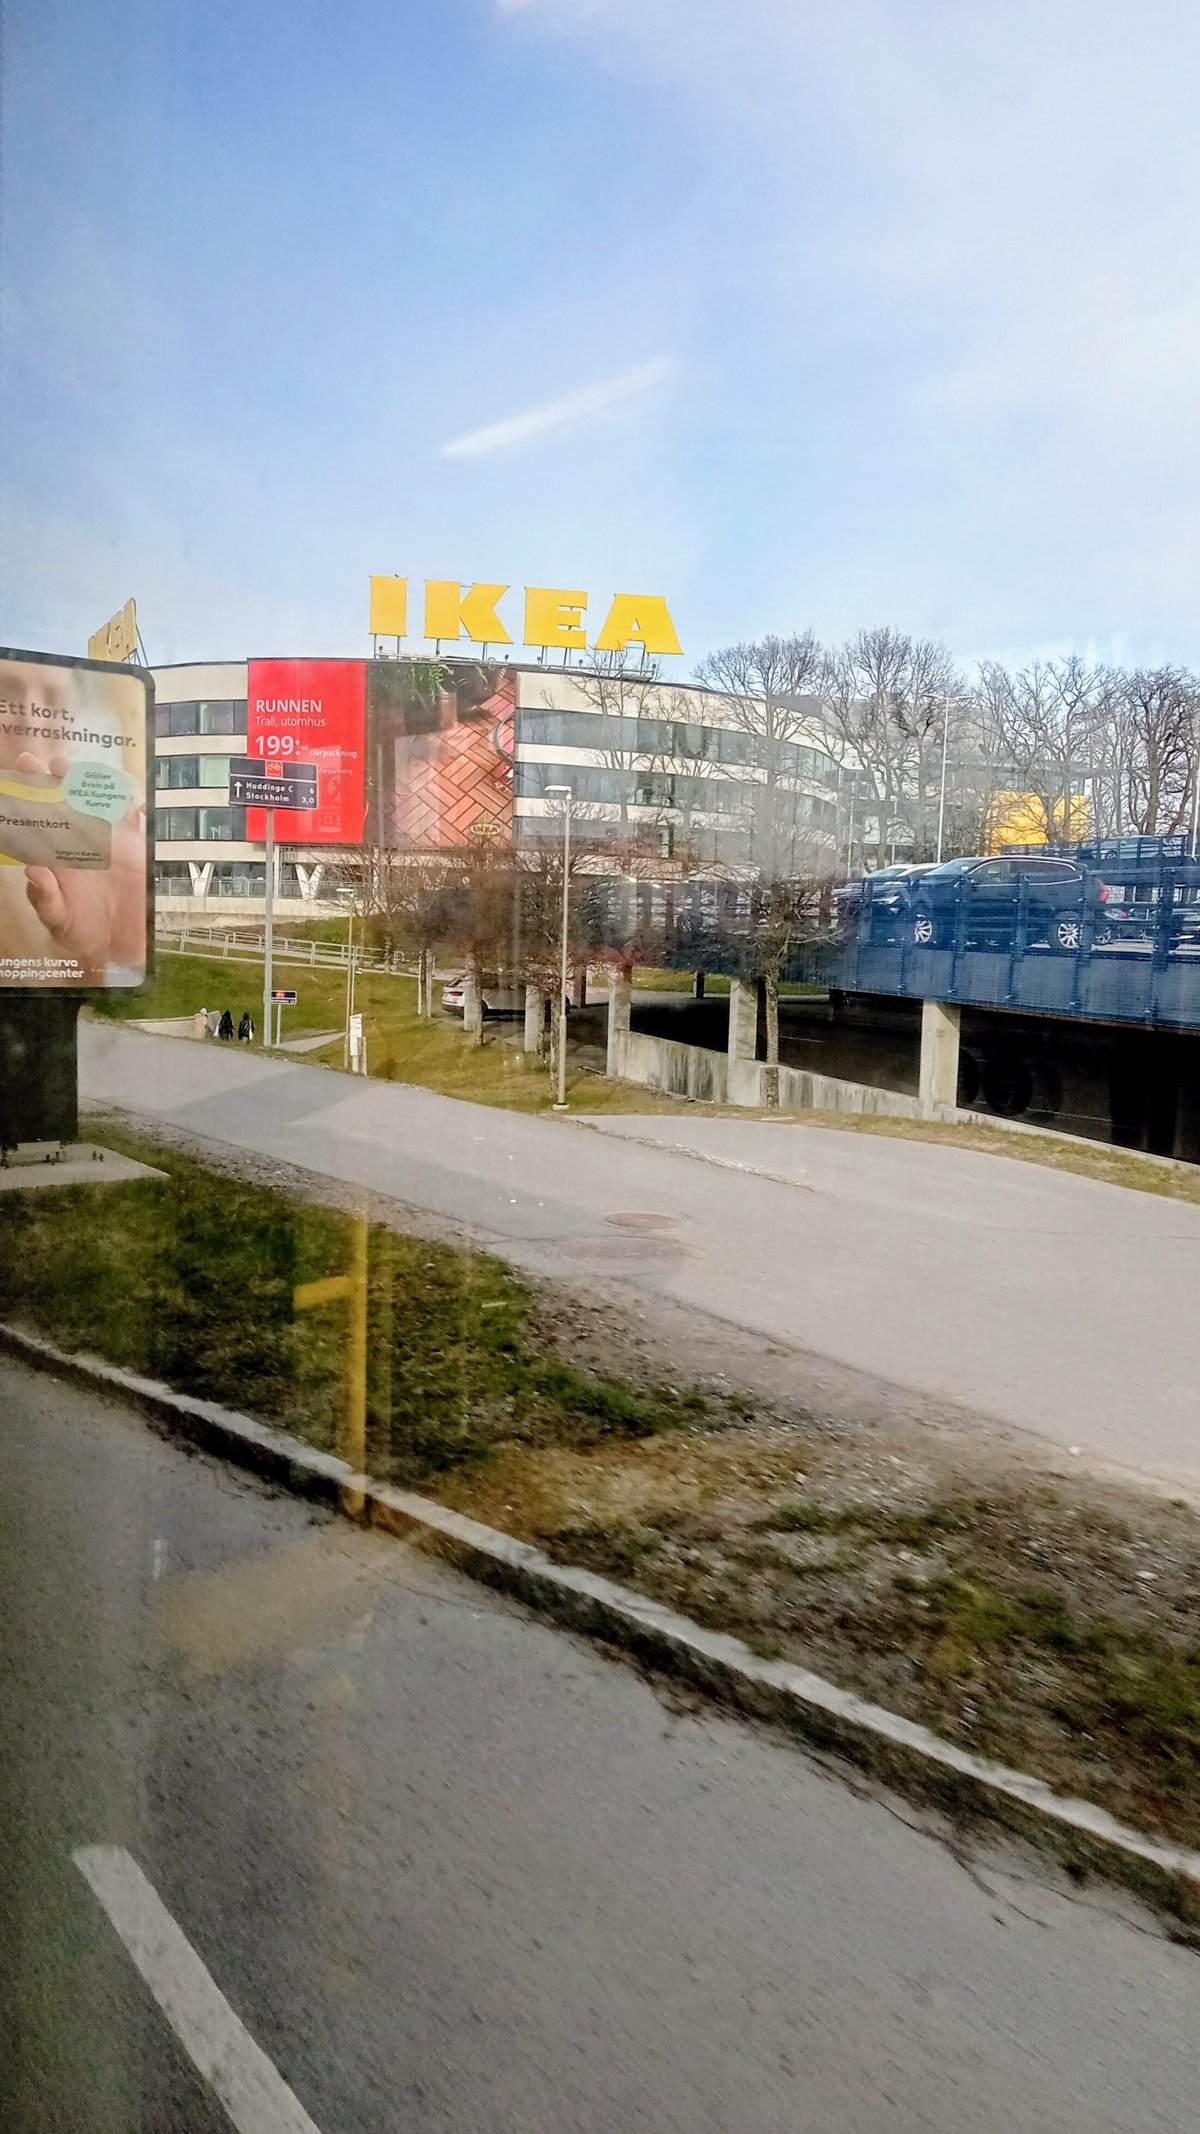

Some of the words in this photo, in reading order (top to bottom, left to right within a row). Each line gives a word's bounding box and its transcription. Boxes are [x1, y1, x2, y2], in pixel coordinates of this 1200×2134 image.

[369, 574, 684, 655] IKEA
[256, 699, 323, 713] RUNNEN
[31, 703, 75, 723] kort,
[255, 716, 278, 727] Trall,
[281, 716, 326, 727] utomhus
[0, 724, 136, 748] verraskningar.
[246, 781, 286, 793] Huddinge
[288, 785, 294, 793] C
[309, 786, 315, 794] 6
[246, 792, 290, 803] Stockholm
[44, 957, 79, 967] kurva
